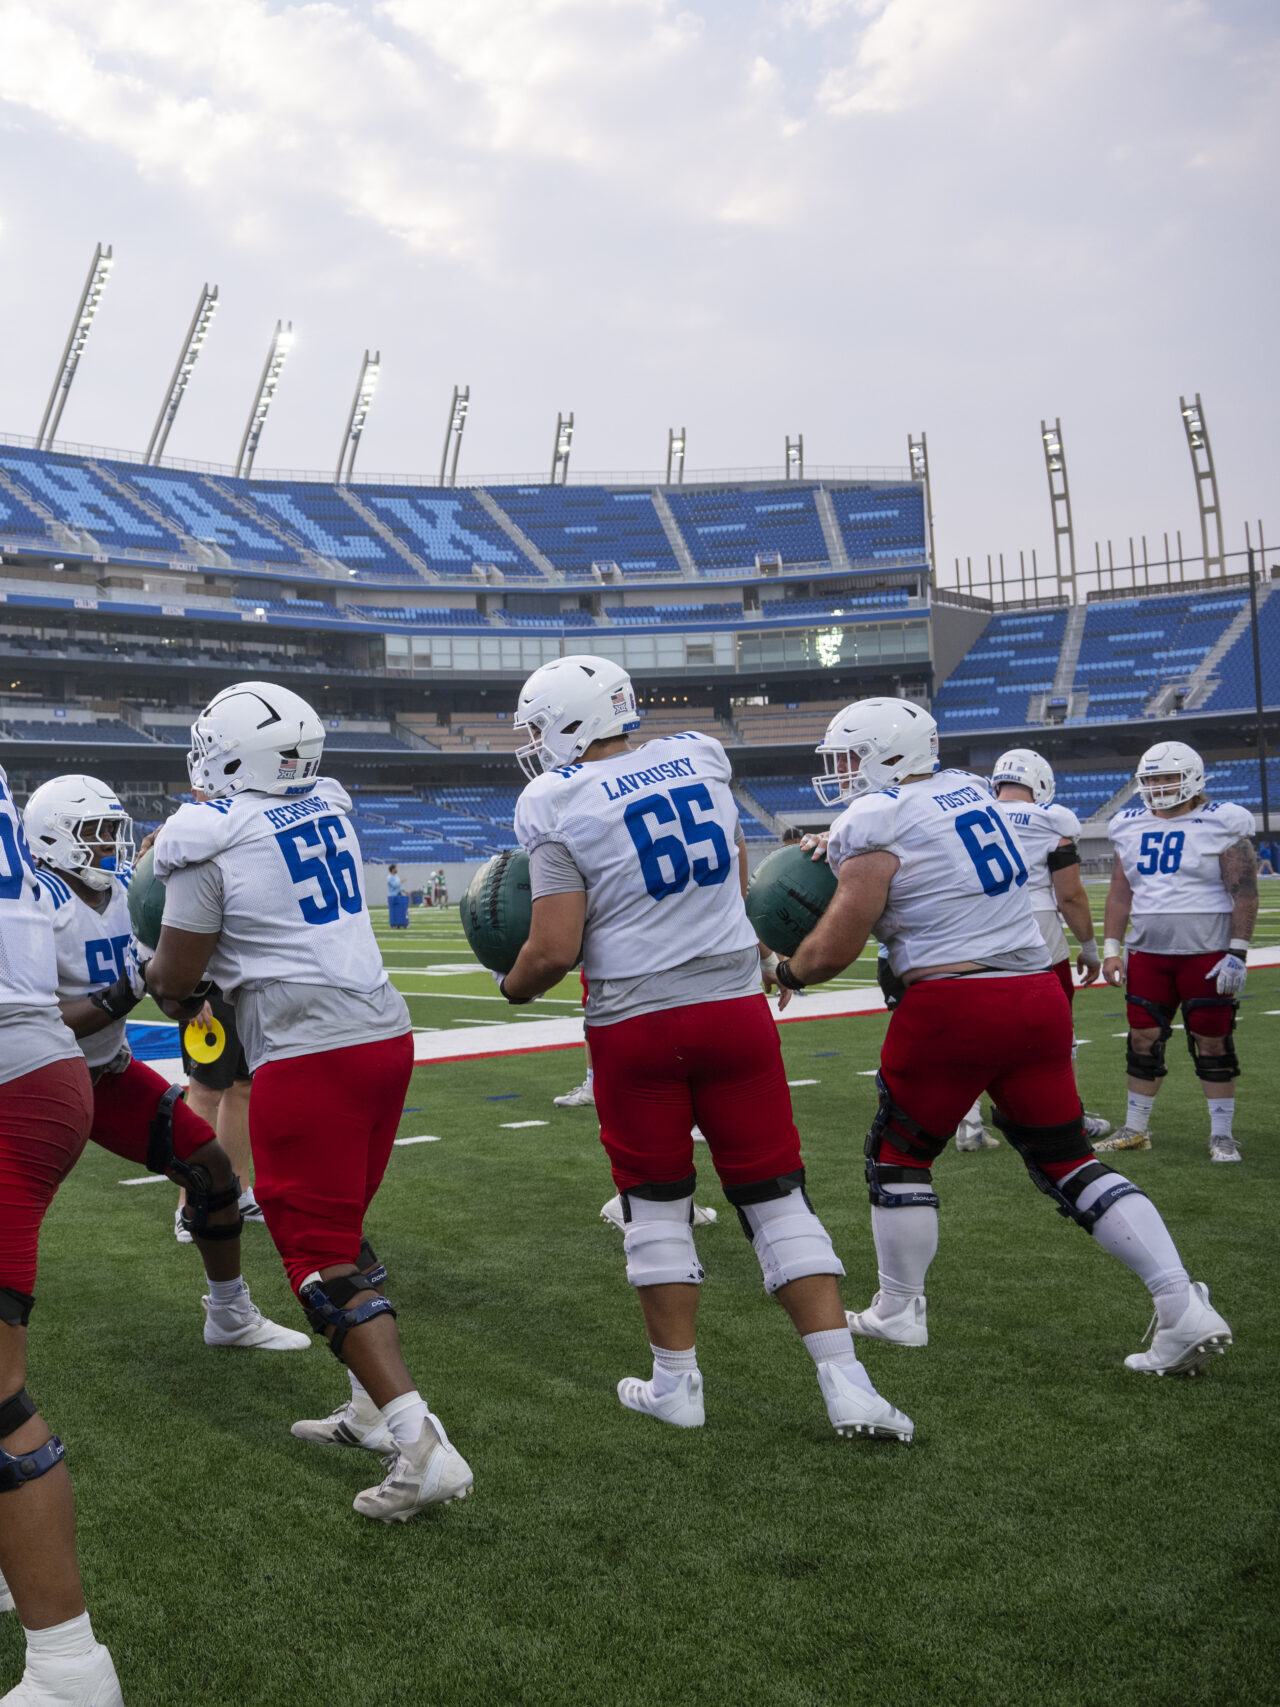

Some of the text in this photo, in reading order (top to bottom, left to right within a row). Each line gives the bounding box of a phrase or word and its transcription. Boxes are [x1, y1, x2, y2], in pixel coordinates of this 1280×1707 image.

[601, 757, 697, 802] LAVRUSKY
[932, 786, 984, 812] FOSTER
[1006, 812, 1032, 826] TON
[623, 782, 731, 902] 65
[1137, 830, 1186, 876] 58
[274, 814, 363, 926] 56
